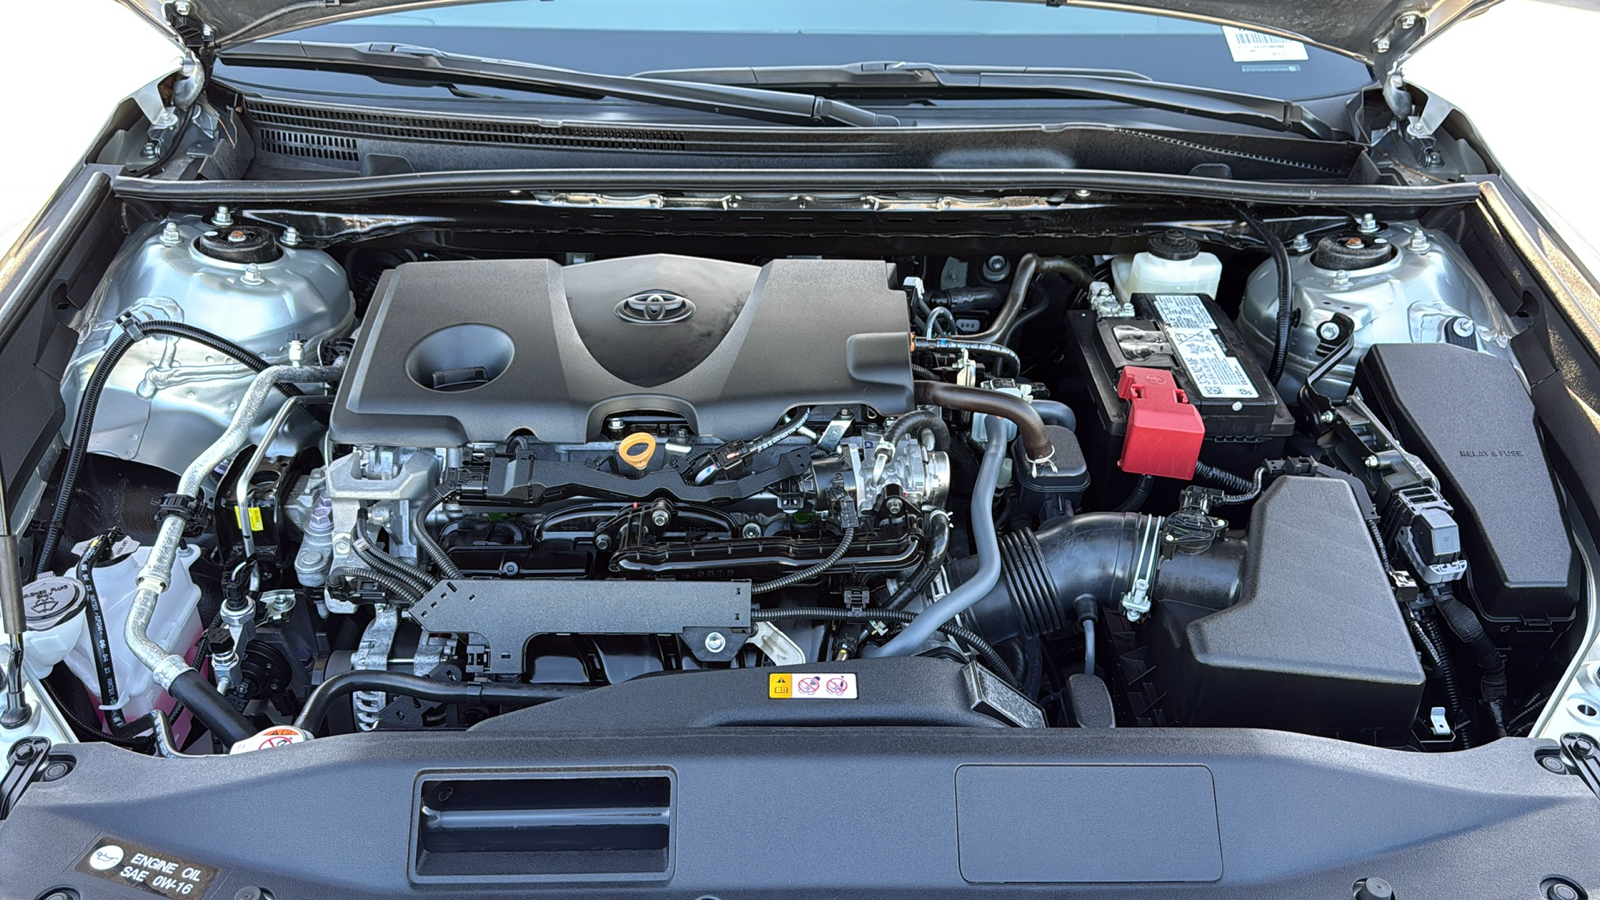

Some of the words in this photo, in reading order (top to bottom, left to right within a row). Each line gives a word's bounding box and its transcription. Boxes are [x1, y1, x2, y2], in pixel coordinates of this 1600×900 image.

[89, 593, 98, 611] WATER
[104, 666, 110, 674] 23
[107, 677, 115, 696] WATER
[120, 866, 149, 882] SAE
[152, 875, 193, 895] 0W-16
[130, 853, 179, 874] ENGINE
[181, 867, 202, 881] OIL
